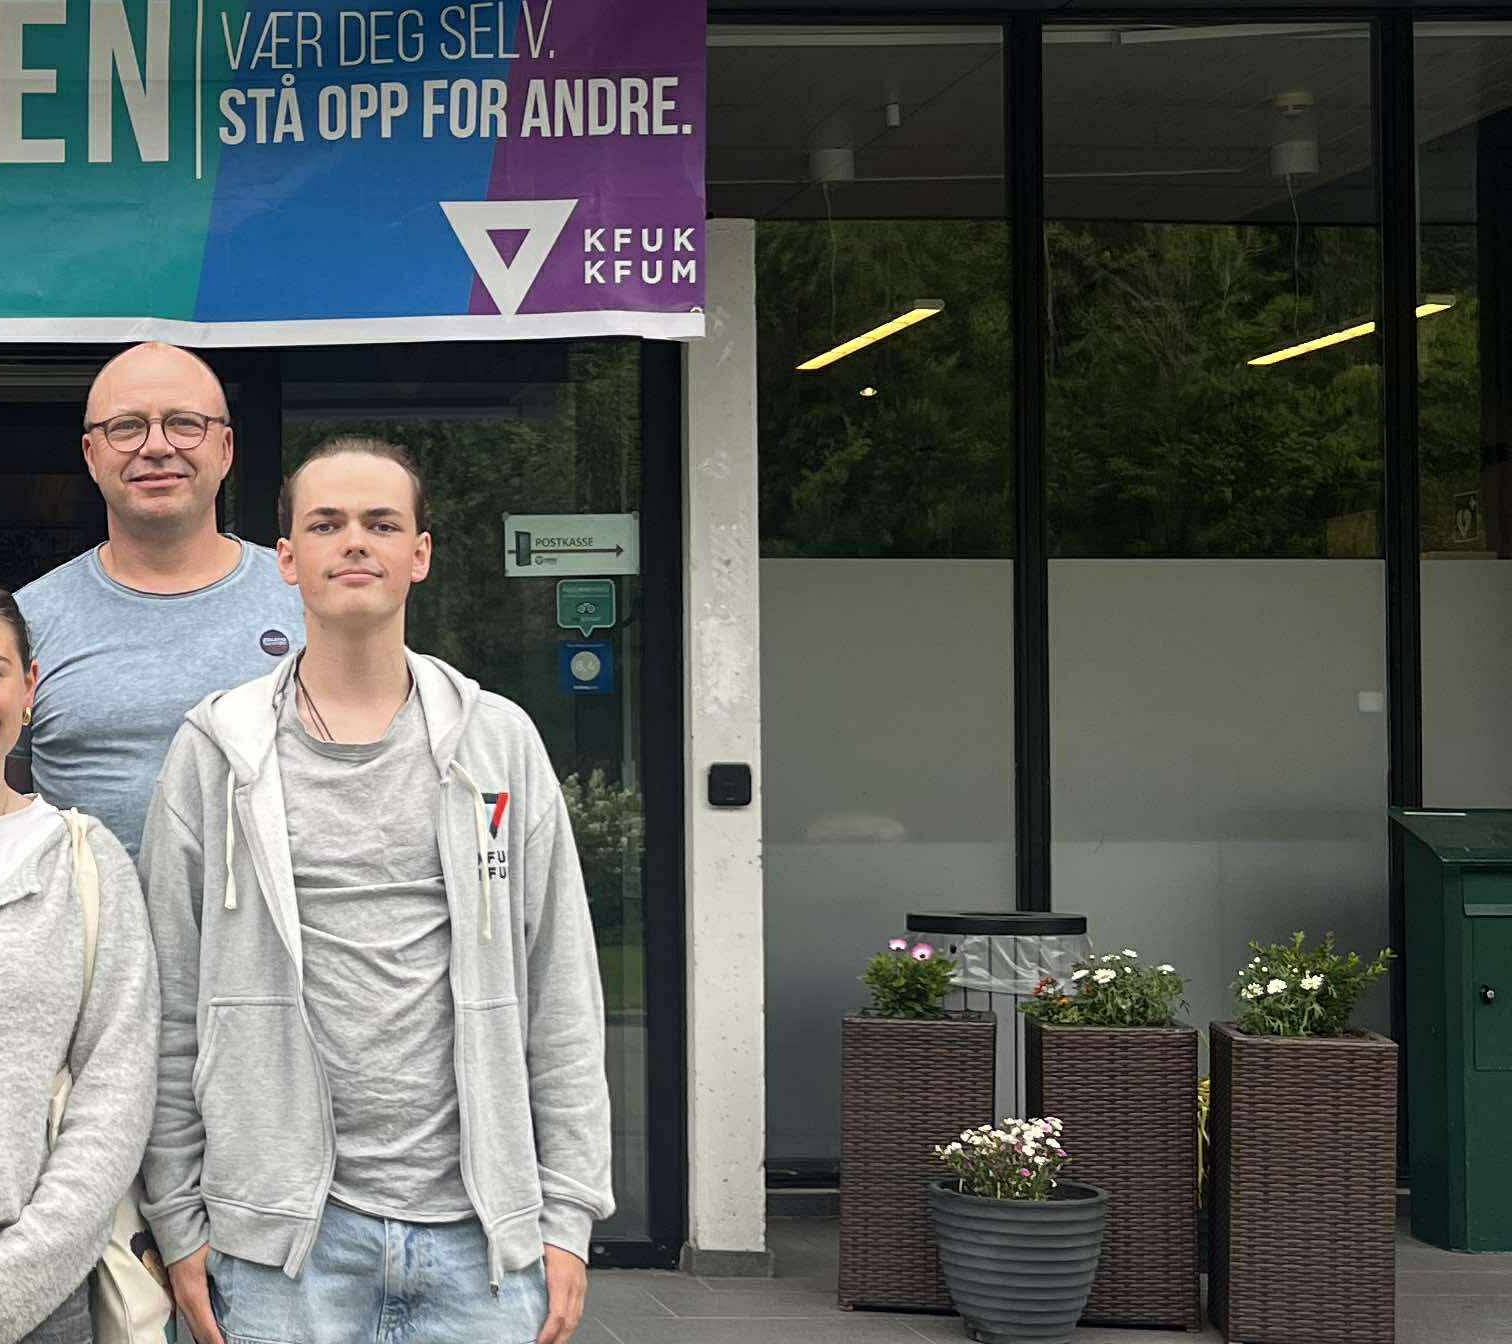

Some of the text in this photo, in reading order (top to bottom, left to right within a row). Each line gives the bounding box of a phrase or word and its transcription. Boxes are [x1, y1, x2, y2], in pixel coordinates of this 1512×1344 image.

[220, 0, 556, 70] VÆR DEG SELV.
[218, 73, 694, 145] STÅ OPP FOR ANDRE.
[584, 227, 696, 253] KFUK
[584, 259, 697, 285] KFUM
[535, 537, 593, 547] POSTKASSE
